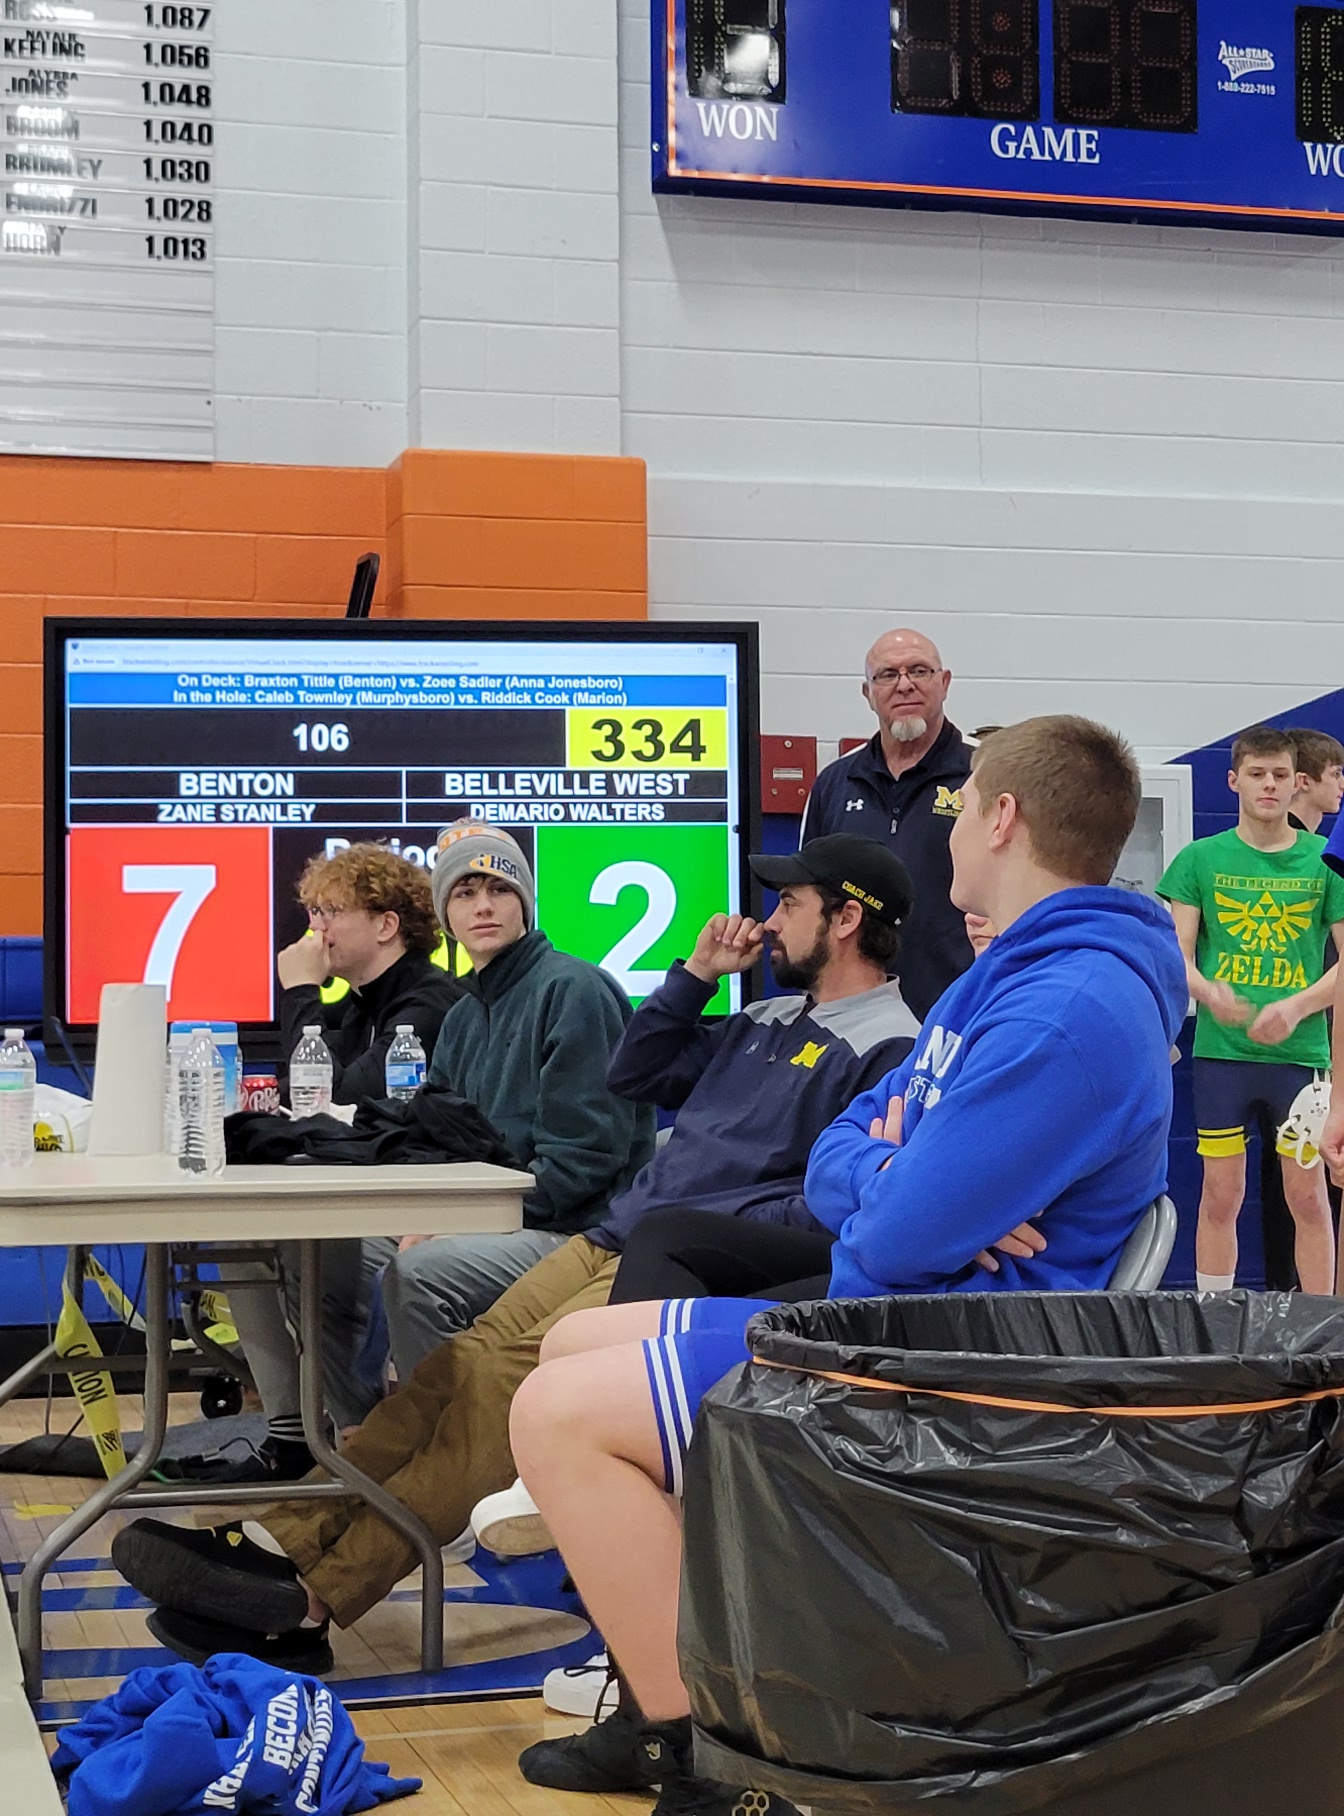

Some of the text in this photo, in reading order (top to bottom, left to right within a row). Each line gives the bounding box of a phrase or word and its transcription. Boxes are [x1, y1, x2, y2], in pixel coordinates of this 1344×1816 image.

[144, 4, 211, 31] 1,087
[4, 38, 211, 69] KEELING 1,056
[5, 76, 212, 109] JONES 1,048
[143, 119, 213, 146] 1,040
[696, 103, 780, 141] WON
[989, 123, 1101, 165] GAME
[143, 157, 211, 184] 1,030
[145, 196, 213, 224] 1,028
[145, 235, 208, 262] 1,013
[177, 674, 624, 692] On Deck: Braxton Tittle (Benton) vs. Zoee Sadler (Anna Jonesboro)
[173, 690, 628, 708] In the Hole: Caleb Townley (Murphysboro) vs. Riddick Cook (Marion)
[292, 722, 350, 752] 106
[590, 718, 707, 763] 334
[179, 772, 295, 796] BENTON
[445, 773, 690, 796] BELLEVILLE WEST
[934, 785, 965, 811] M
[157, 803, 317, 822] ZANE STANLEY
[470, 803, 666, 821] DEMARIO WALTERS
[121, 864, 218, 1003] 7
[588, 861, 678, 998] 2
[1214, 951, 1309, 989] ZELDA
